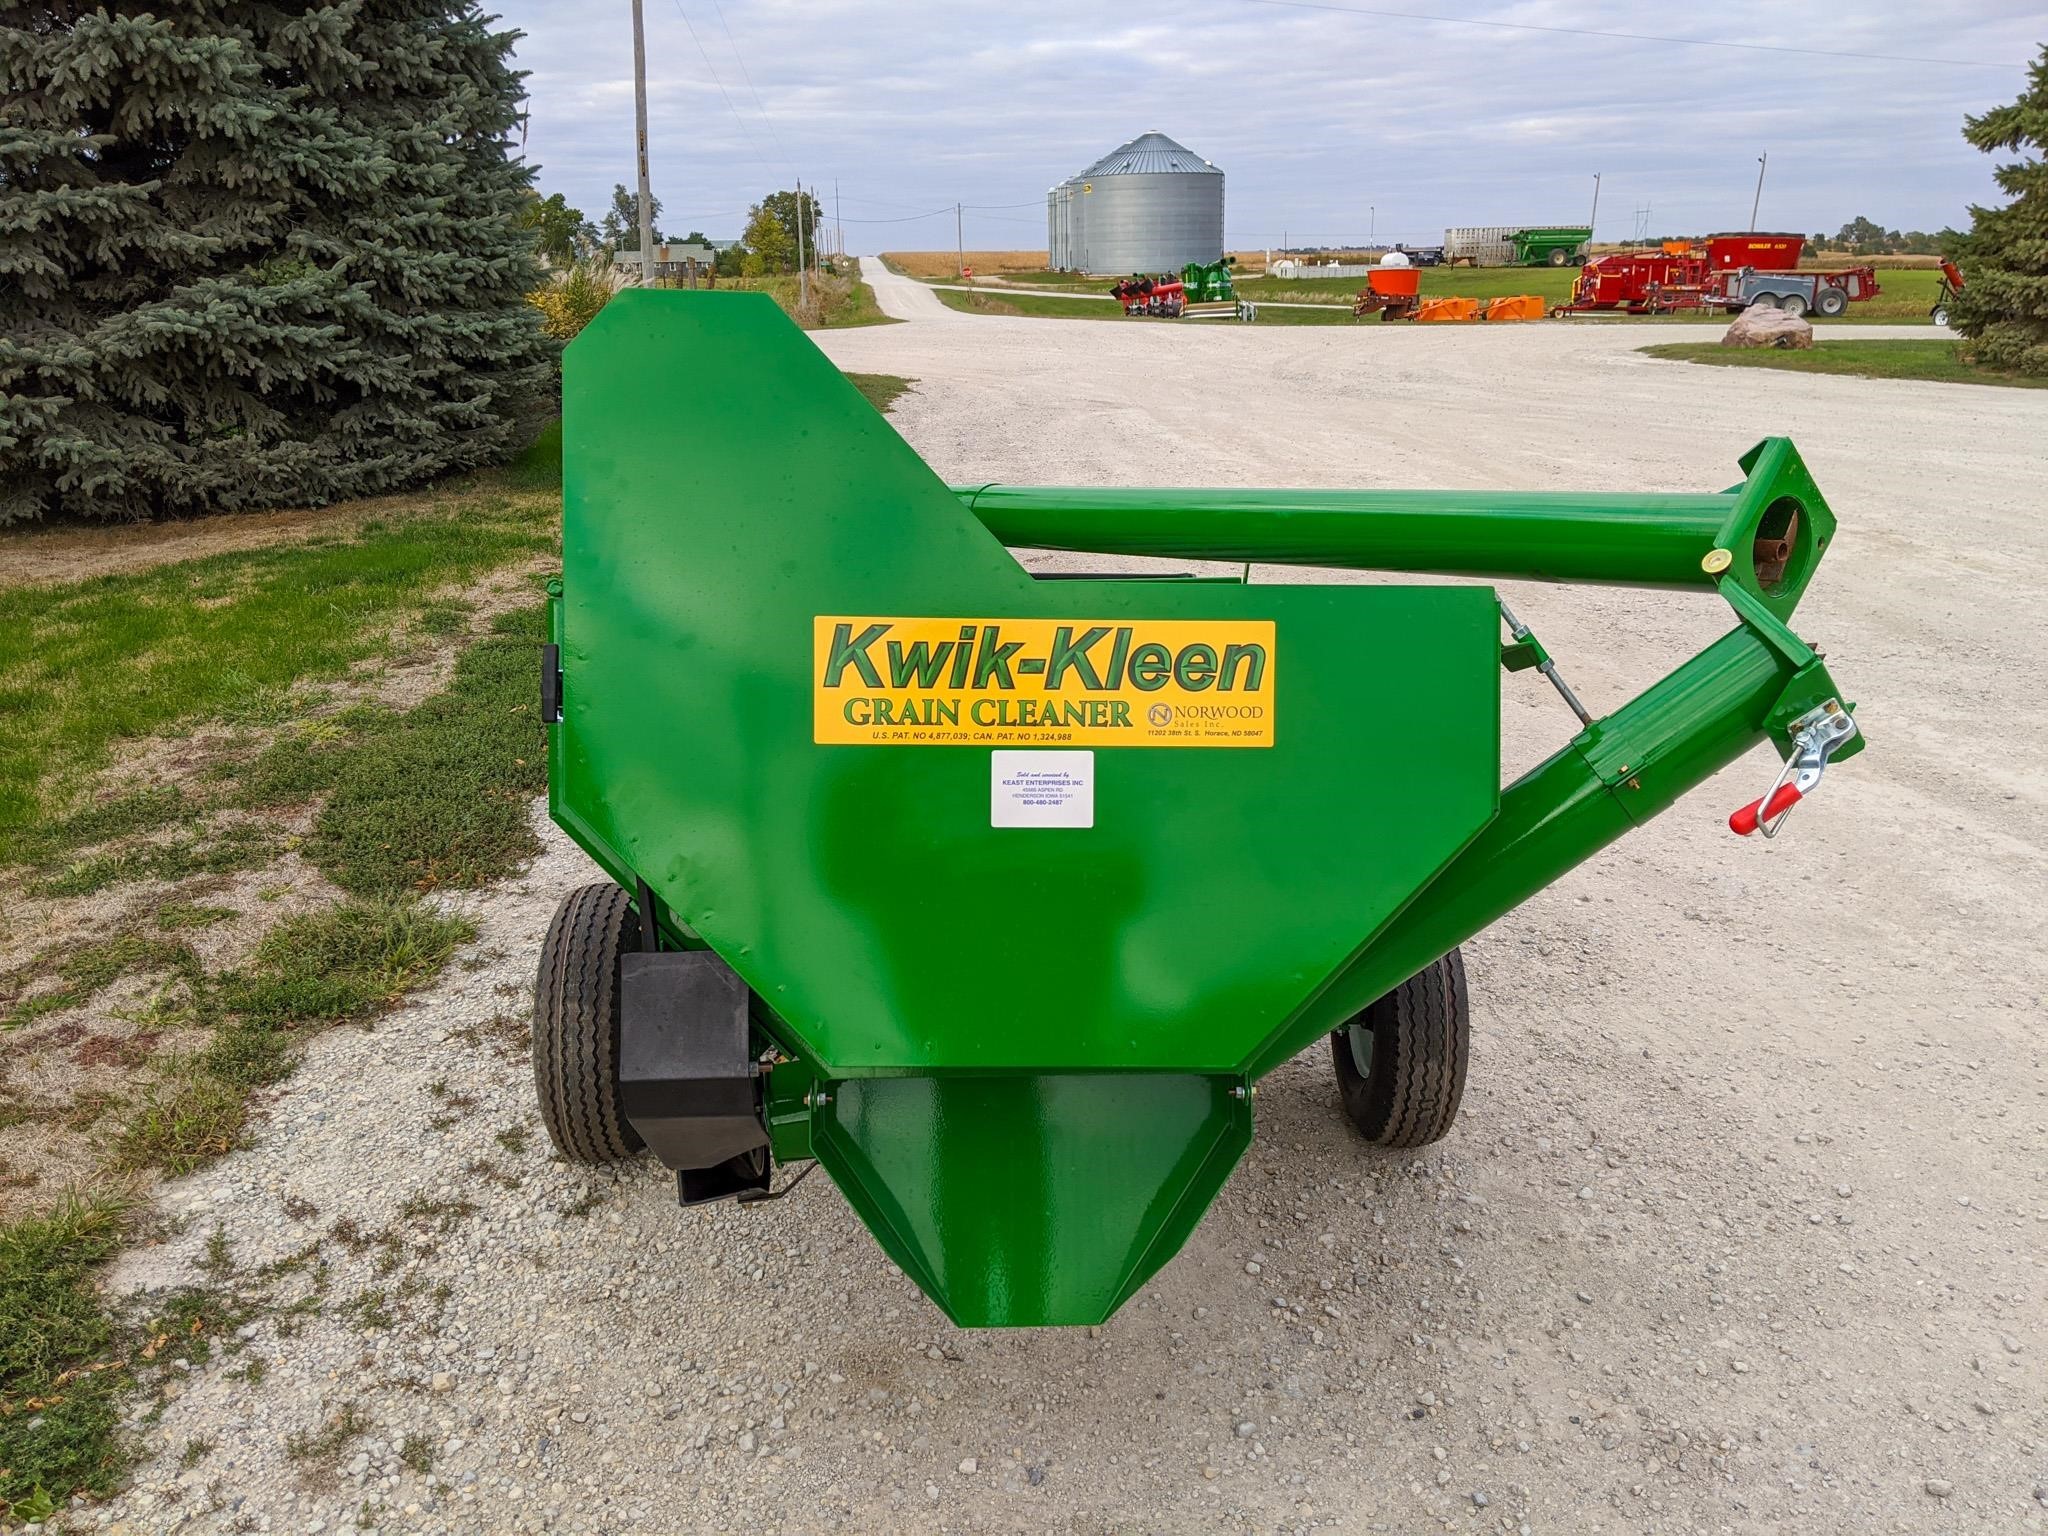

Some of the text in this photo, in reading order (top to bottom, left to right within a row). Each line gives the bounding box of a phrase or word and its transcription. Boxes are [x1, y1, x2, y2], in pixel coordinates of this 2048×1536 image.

[823, 624, 1266, 692] Kwik-Kleen
[843, 698, 1133, 727] GRAIN CLEANER
[1175, 705, 1263, 720] NORWOOD
[1174, 720, 1200, 728] Sales
[872, 731, 889, 739] U.S.
[892, 731, 910, 739] PAT.
[913, 732, 927, 740] NO
[929, 733, 971, 741] 4,877,039;
[973, 732, 995, 740] CAN.
[1017, 733, 1031, 741] NO
[1033, 733, 1072, 741] 1,324,988
